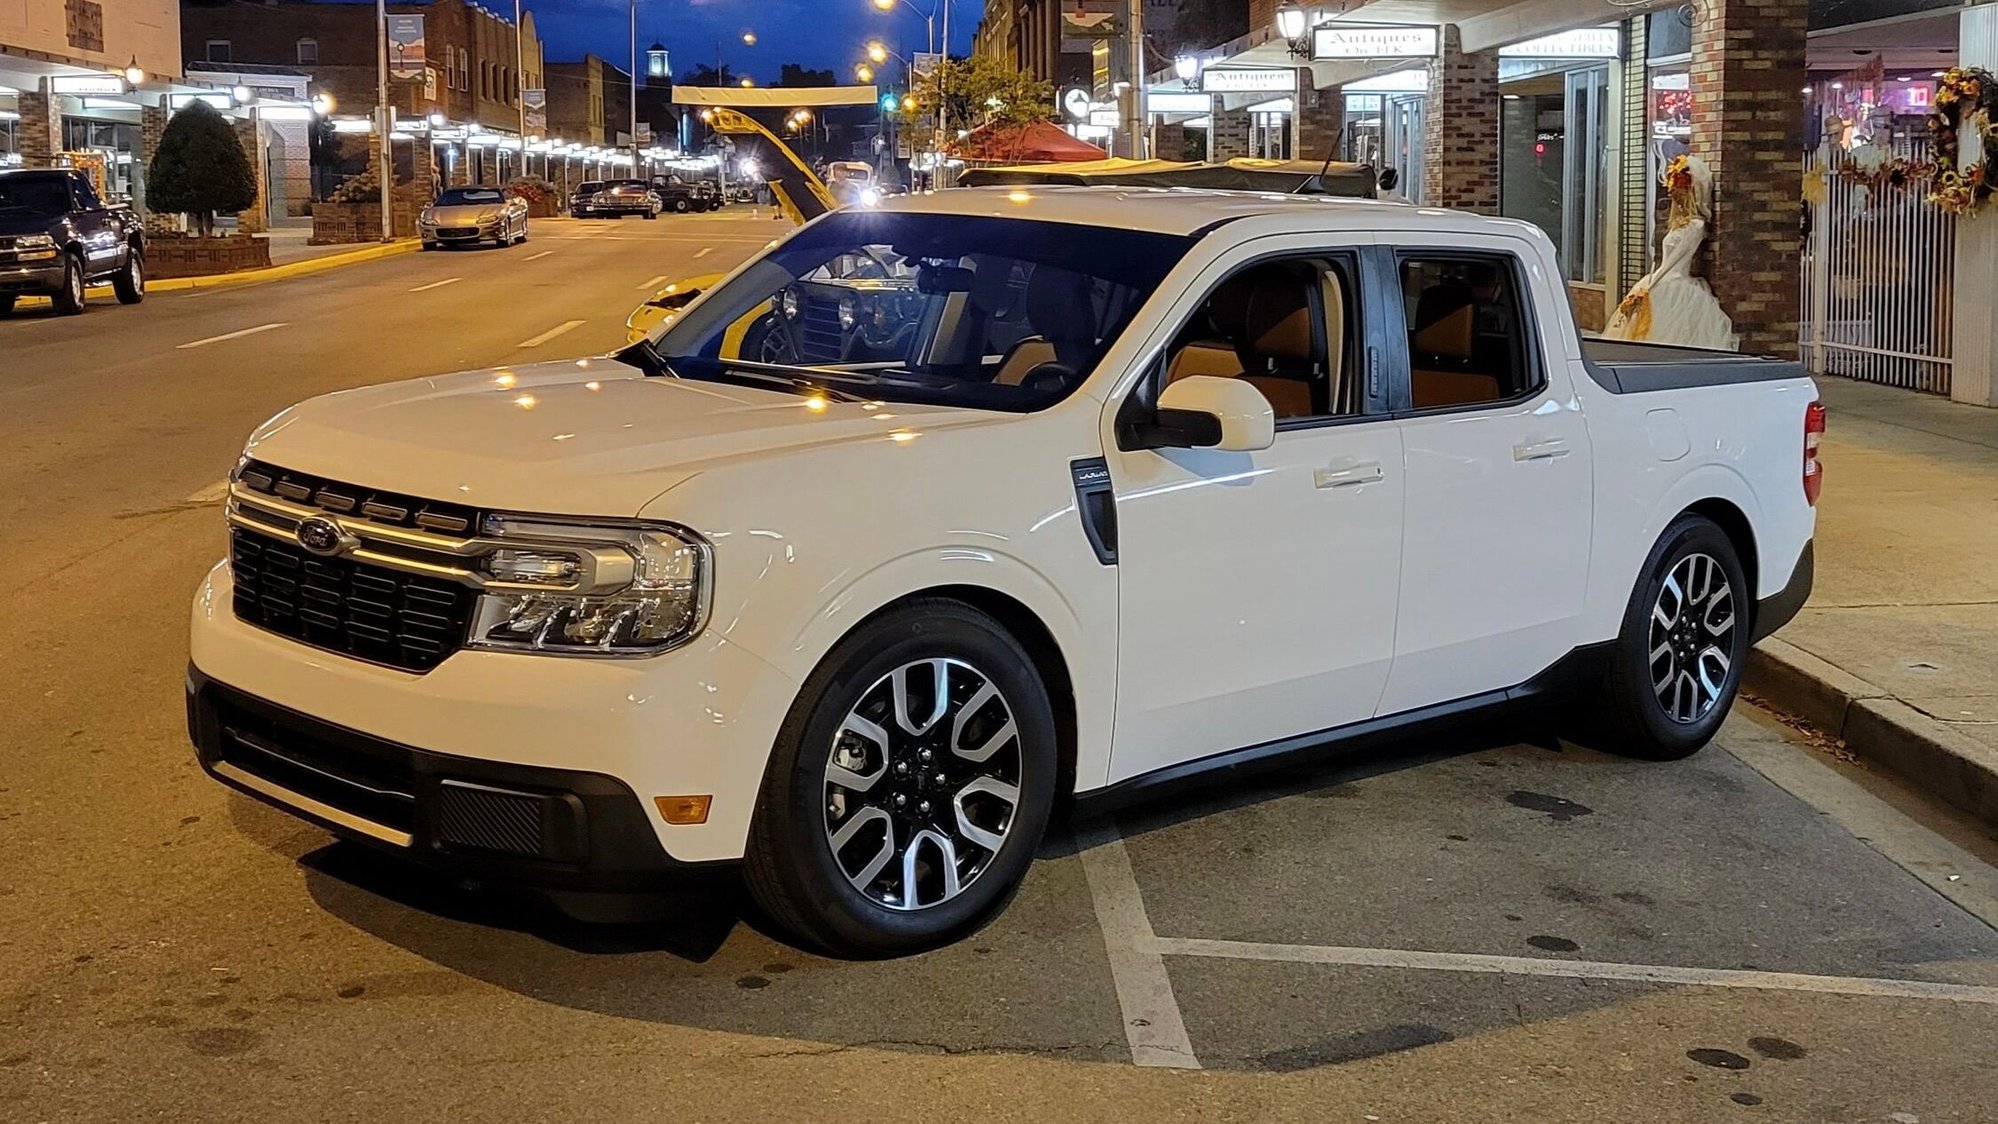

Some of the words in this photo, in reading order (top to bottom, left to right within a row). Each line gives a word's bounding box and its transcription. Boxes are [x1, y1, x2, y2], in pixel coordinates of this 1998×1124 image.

[1329, 33, 1422, 45] Antiques
[1215, 72, 1286, 81] Antiques
[303, 525, 328, 547] Ford
